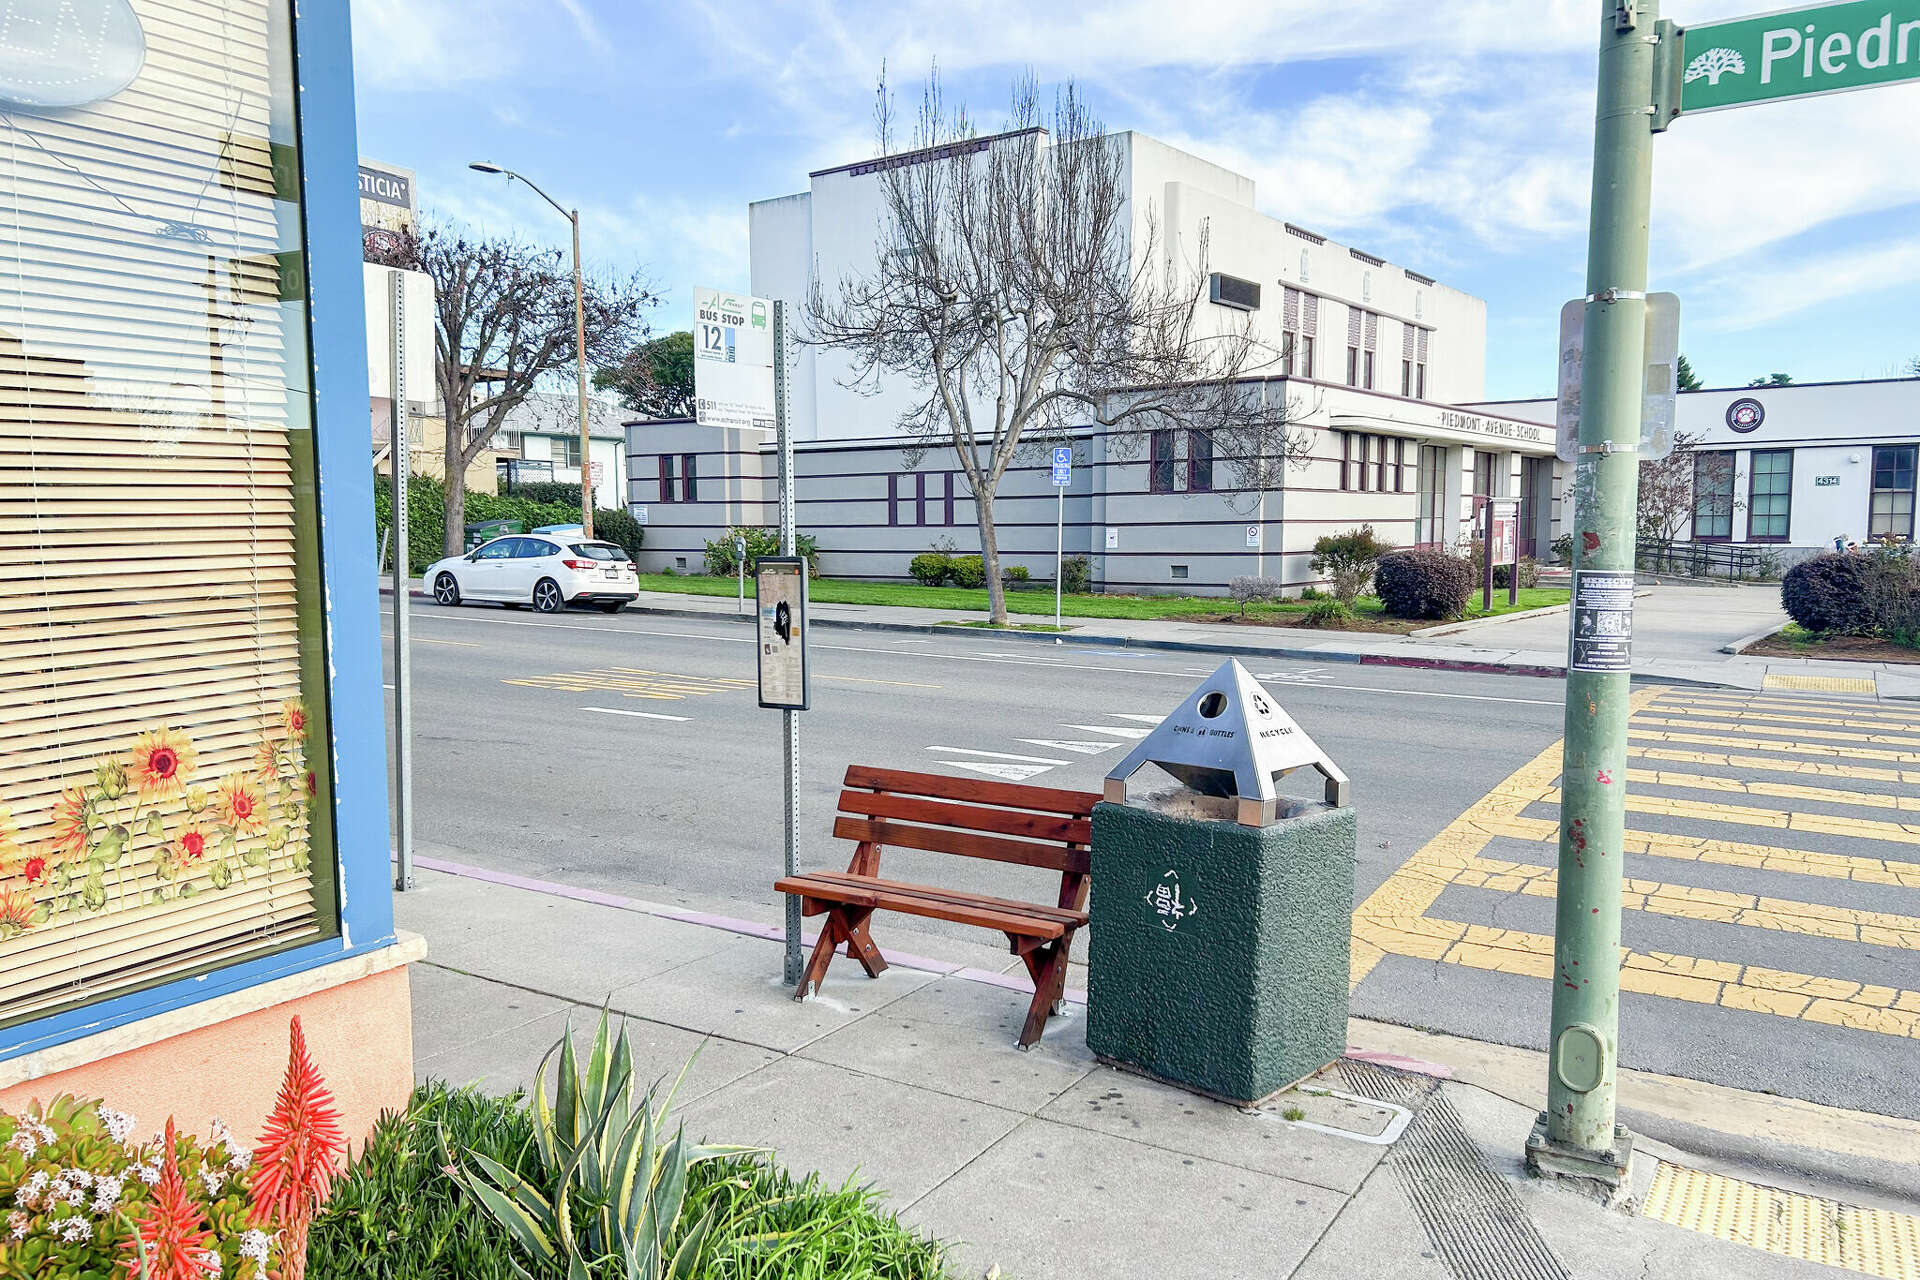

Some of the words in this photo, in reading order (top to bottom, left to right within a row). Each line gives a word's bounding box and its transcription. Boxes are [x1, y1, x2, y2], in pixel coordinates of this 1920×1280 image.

[699, 309, 719, 323] BUS
[721, 313, 745, 326] STOP
[703, 325, 721, 350] 12
[706, 400, 717, 411] 511
[1441, 412, 1481, 432] PIEDMONT
[1485, 422, 1513, 436] AVENUE
[1516, 426, 1540, 440] SCHOOL
[1208, 729, 1235, 738] BOTTLES
[1259, 726, 1294, 738] RECYCLE
